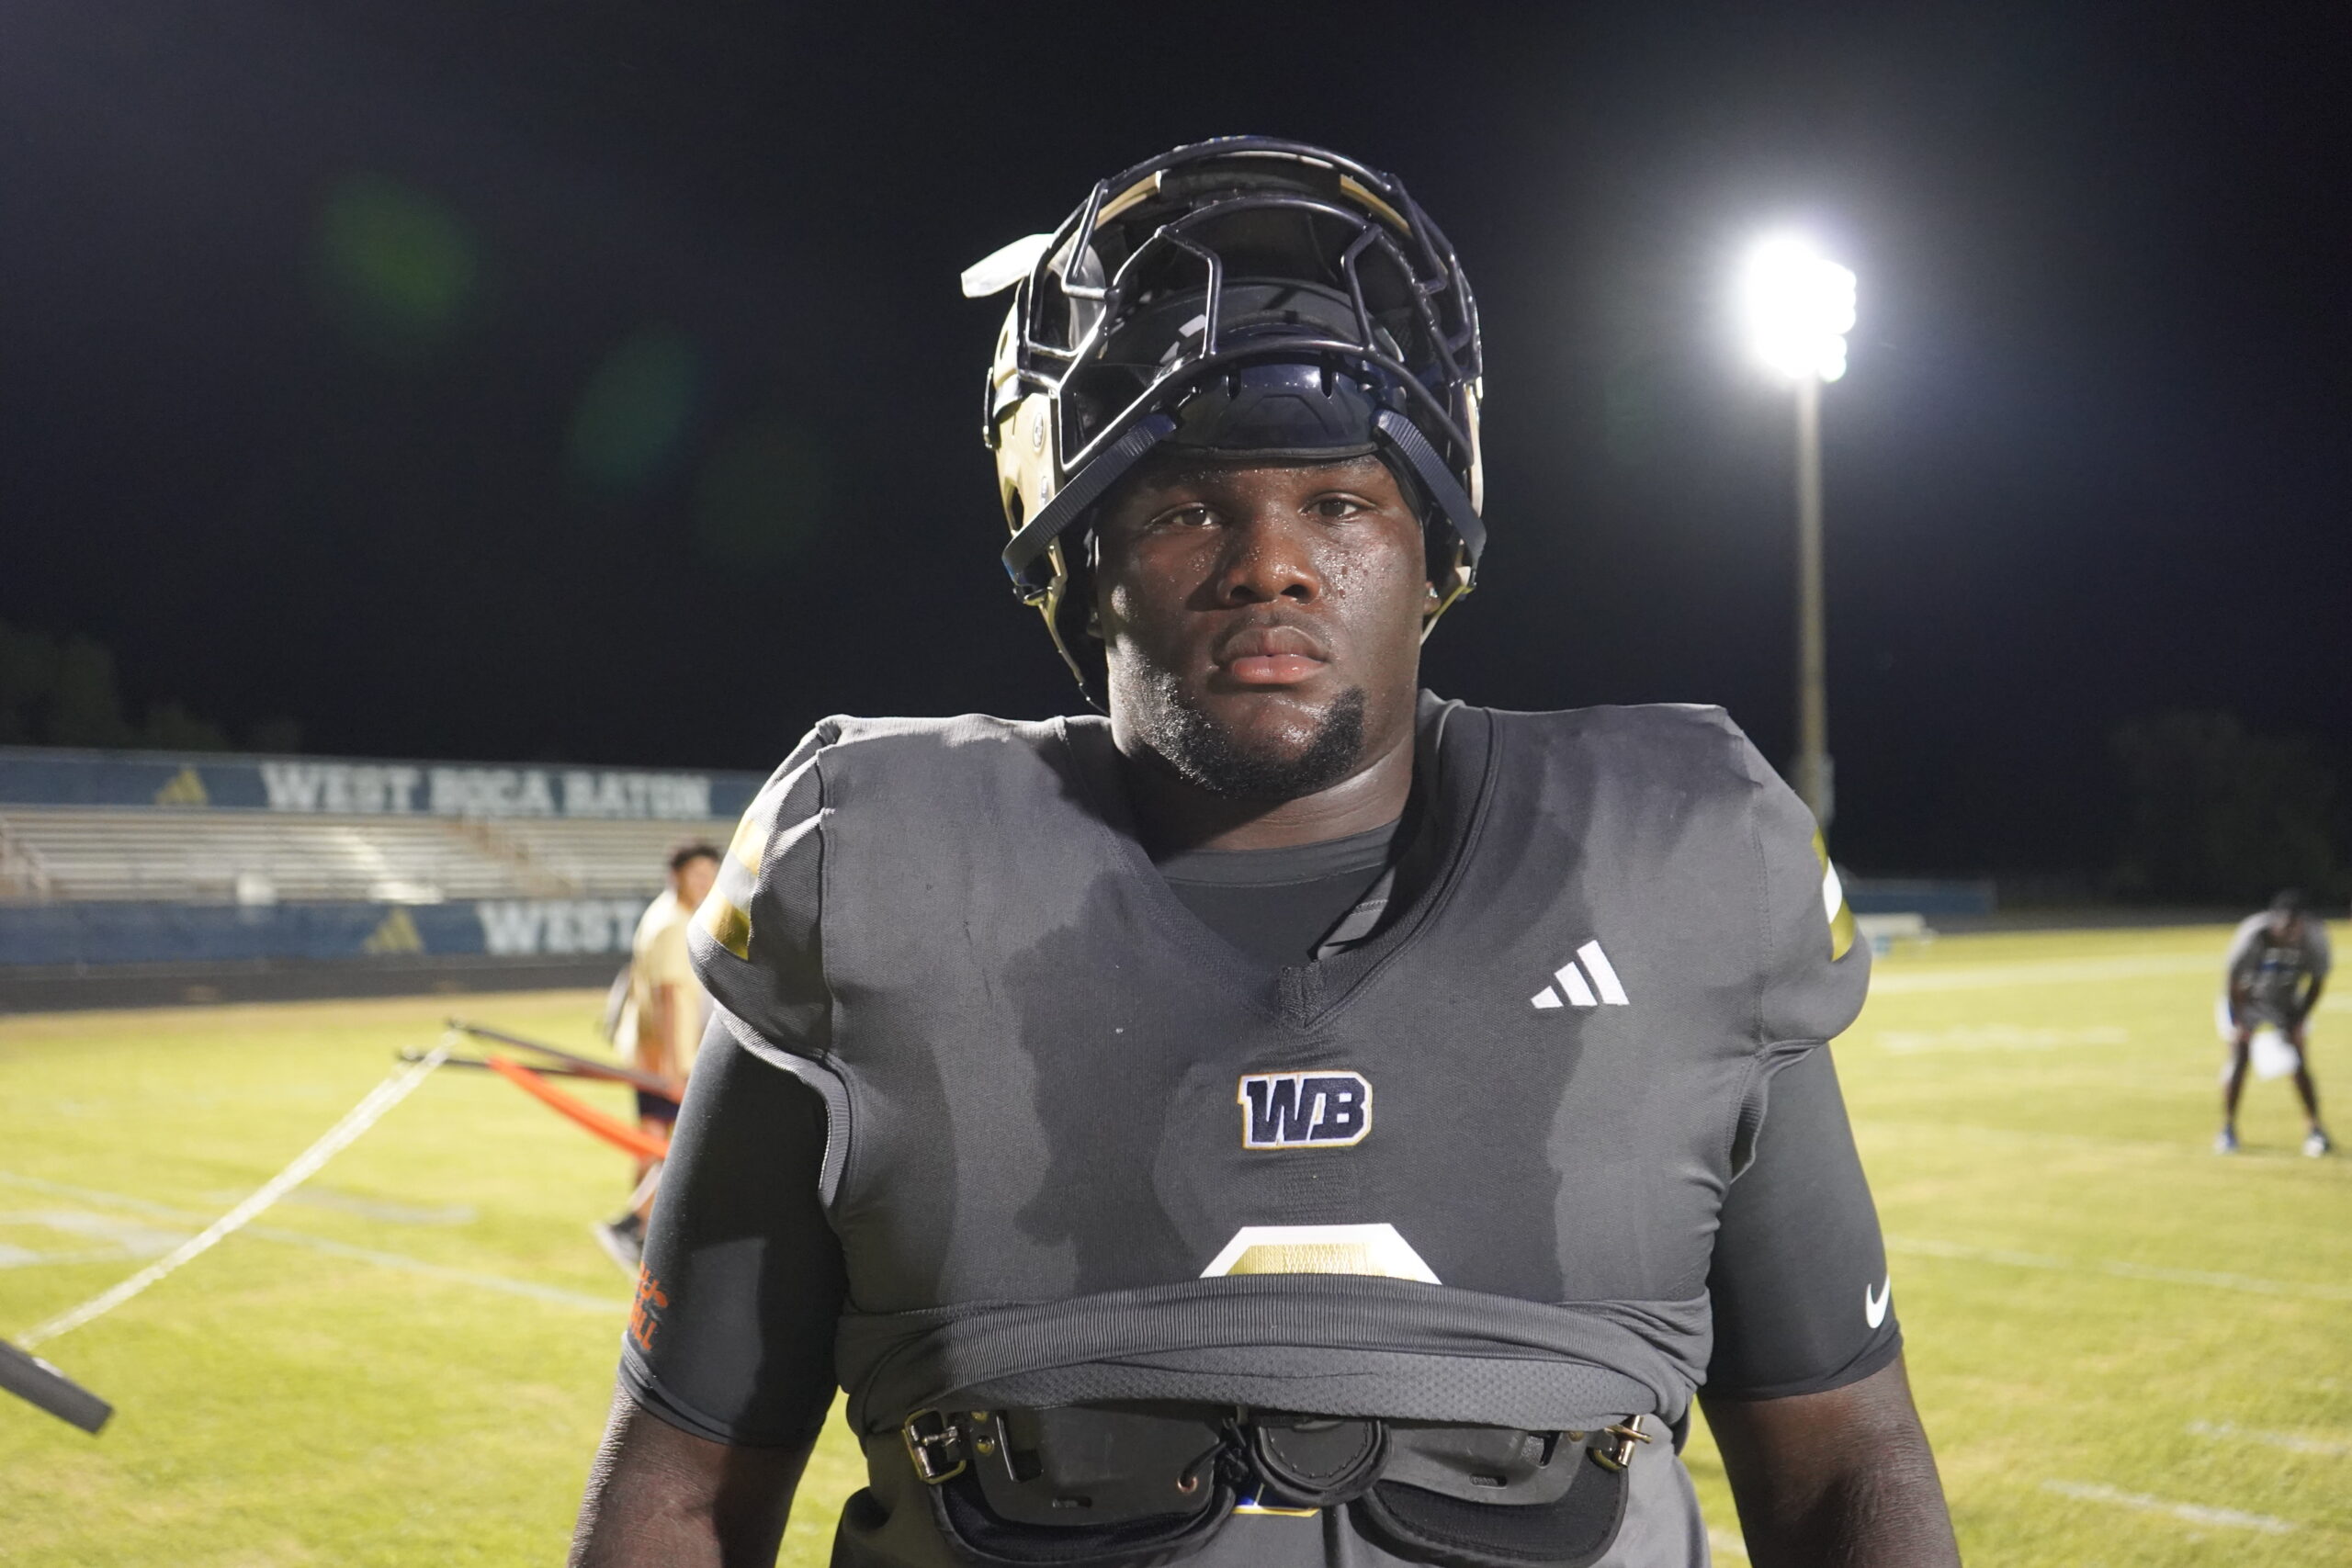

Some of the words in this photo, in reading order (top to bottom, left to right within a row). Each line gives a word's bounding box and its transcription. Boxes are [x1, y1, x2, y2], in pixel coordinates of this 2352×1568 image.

[261, 762, 419, 812] WEST
[478, 899, 642, 953] WEST
[1238, 1072, 1372, 1149] WB
